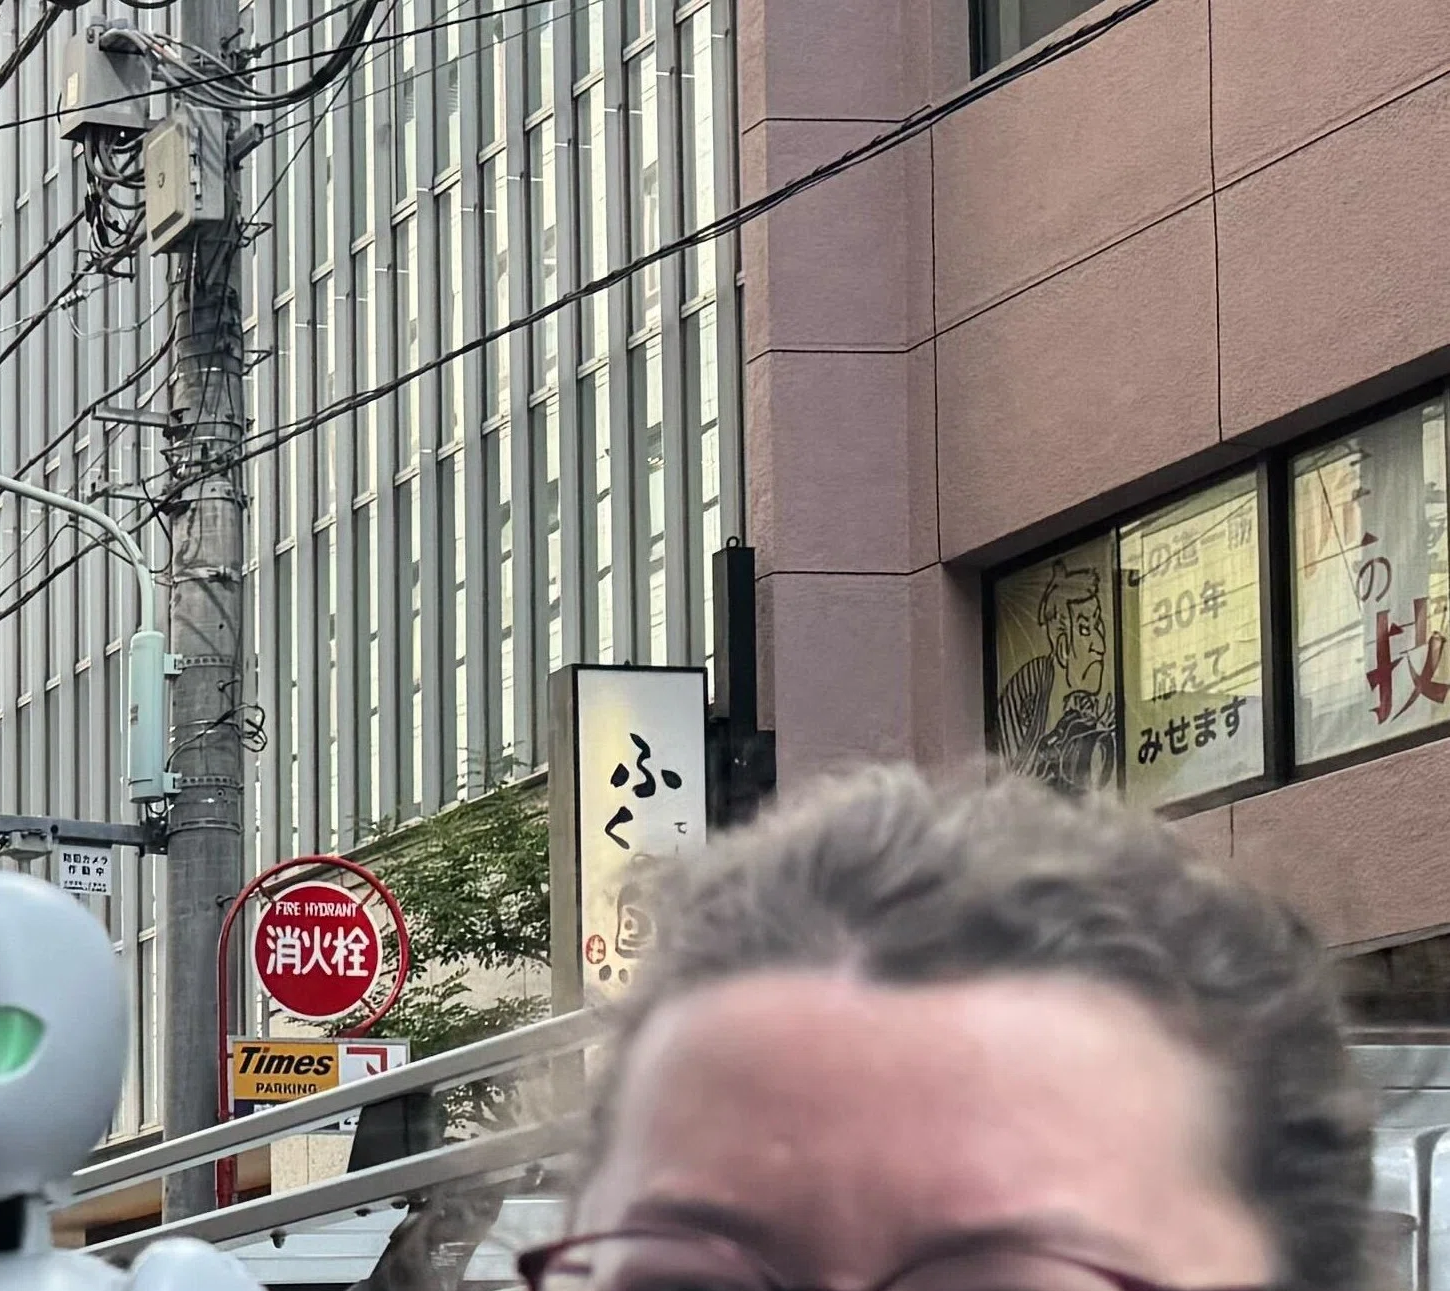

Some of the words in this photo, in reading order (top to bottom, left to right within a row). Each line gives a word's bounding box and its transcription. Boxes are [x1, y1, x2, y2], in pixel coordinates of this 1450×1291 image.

[1152, 578, 1227, 638] 30年
[1138, 697, 1247, 765] みせます
[275, 901, 301, 917] FIRE
[304, 901, 358, 918] HYDRANT
[265, 924, 371, 978] 消火栓
[238, 1045, 335, 1077] Times
[255, 1082, 318, 1095] PARKING
